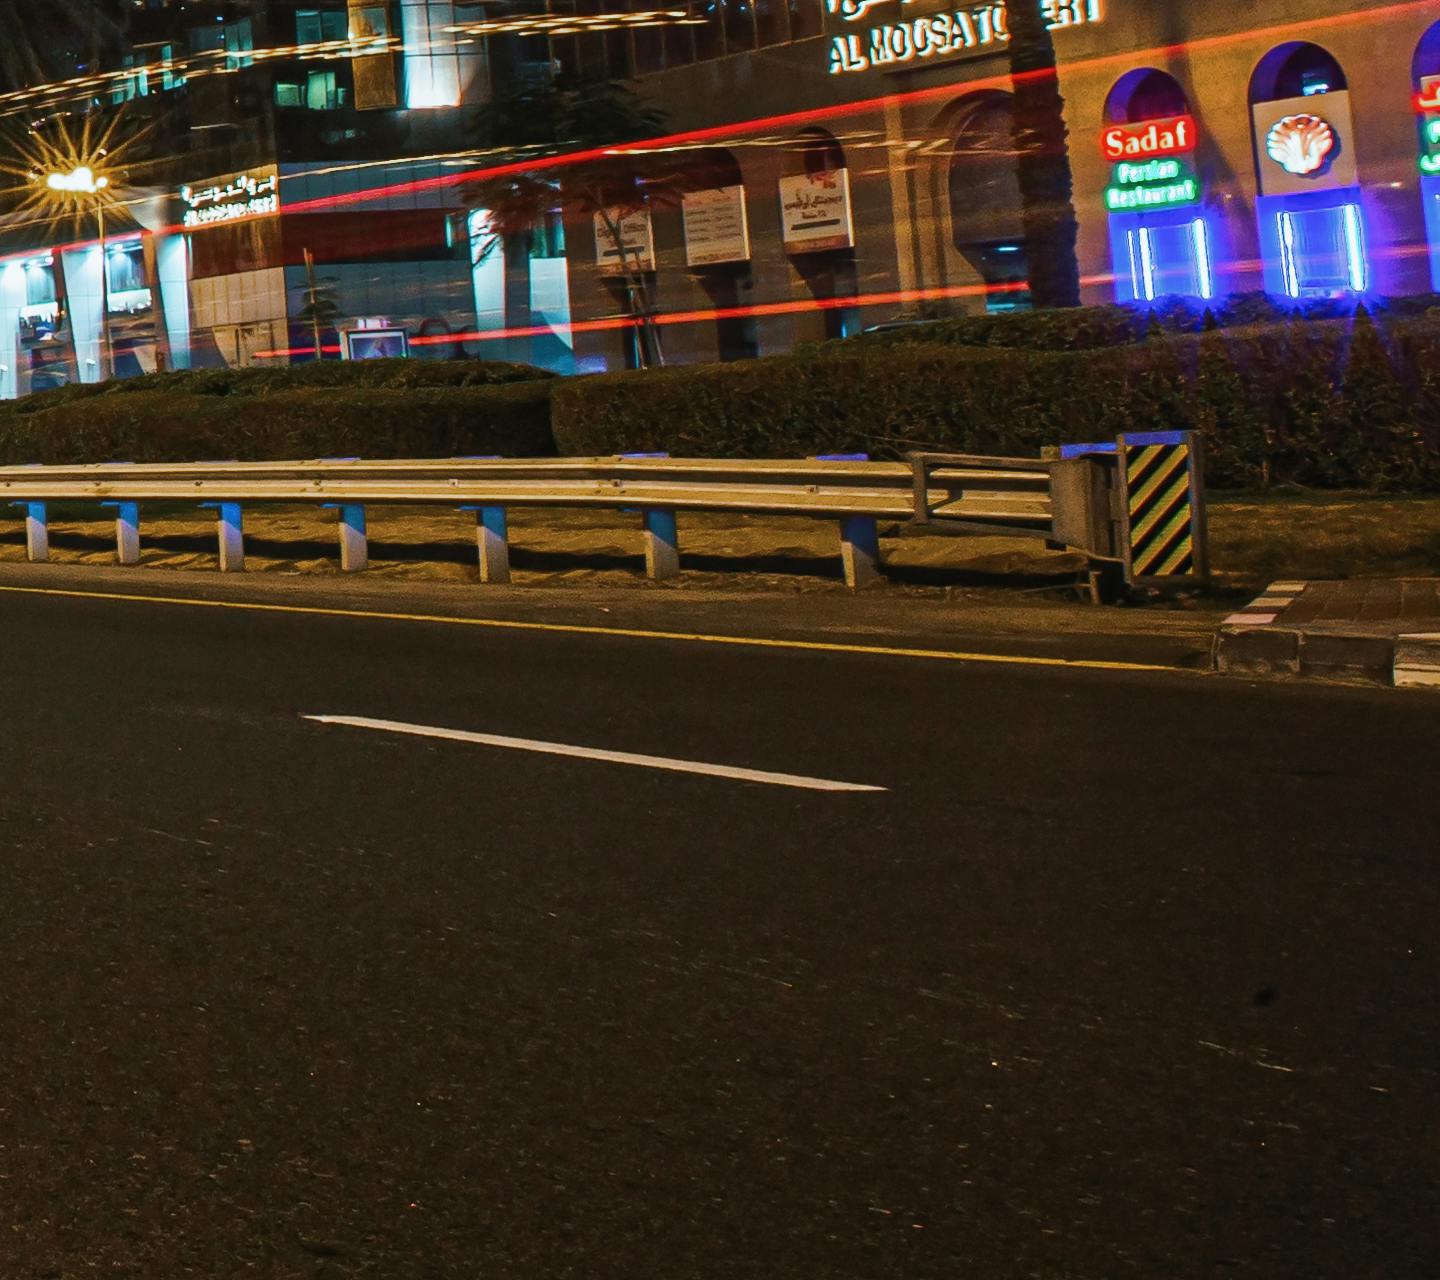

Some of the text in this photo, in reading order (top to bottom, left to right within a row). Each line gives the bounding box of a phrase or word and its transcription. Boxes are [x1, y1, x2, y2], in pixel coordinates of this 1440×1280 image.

[829, 34, 869, 75] AL
[1105, 121, 1187, 157] Sadaf
[1117, 161, 1179, 183] Persian
[1108, 181, 1196, 209] Restaurant
